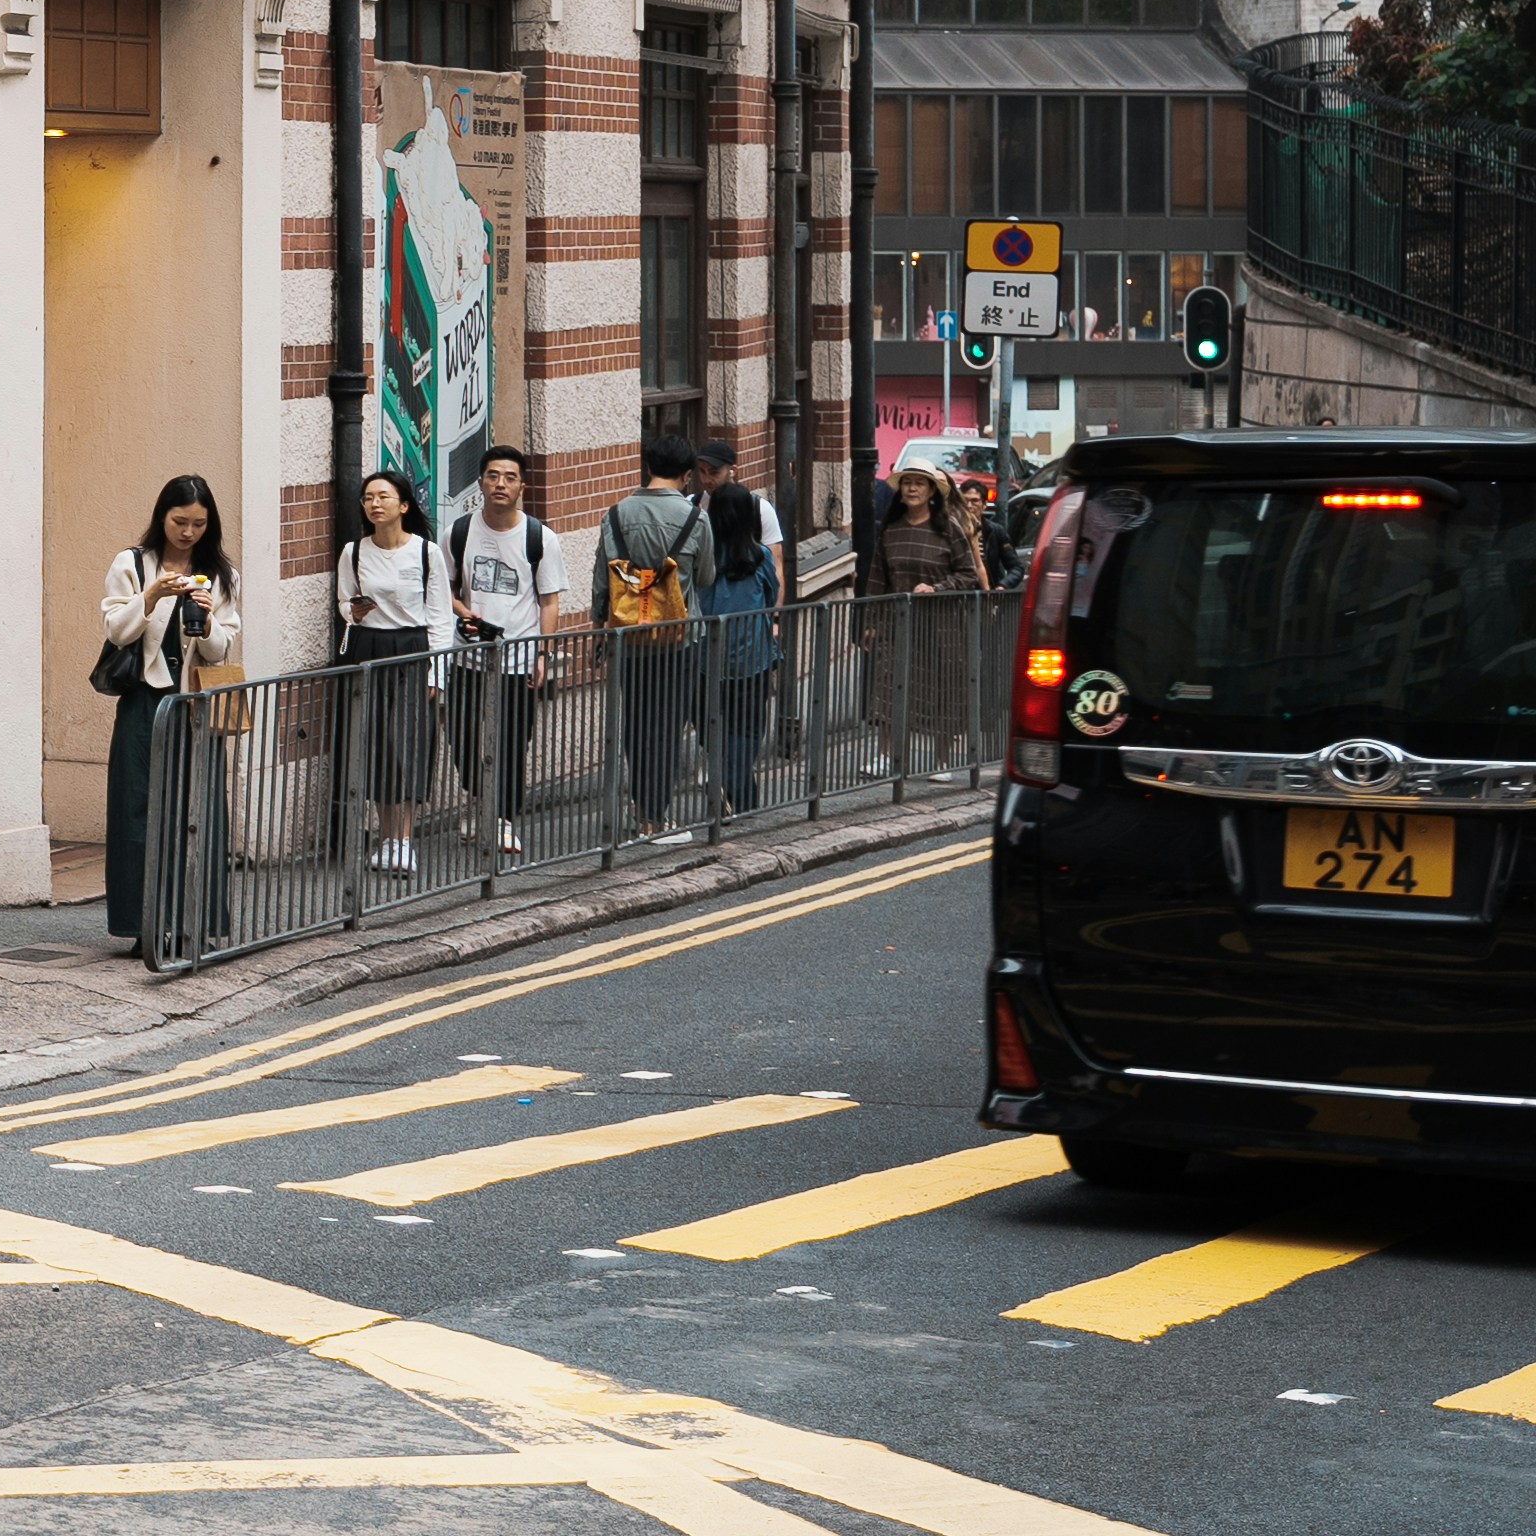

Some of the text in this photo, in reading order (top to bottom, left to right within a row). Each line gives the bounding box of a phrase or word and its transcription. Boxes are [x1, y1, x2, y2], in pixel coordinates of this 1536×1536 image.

[992, 280, 1031, 299] End
[980, 304, 1040, 329] 終止
[443, 290, 486, 384] WORDS
[459, 368, 484, 430] ALL
[875, 404, 937, 431] Mini
[1075, 689, 1119, 716] 80
[1337, 812, 1406, 853] AN
[1314, 852, 1418, 894] 274
